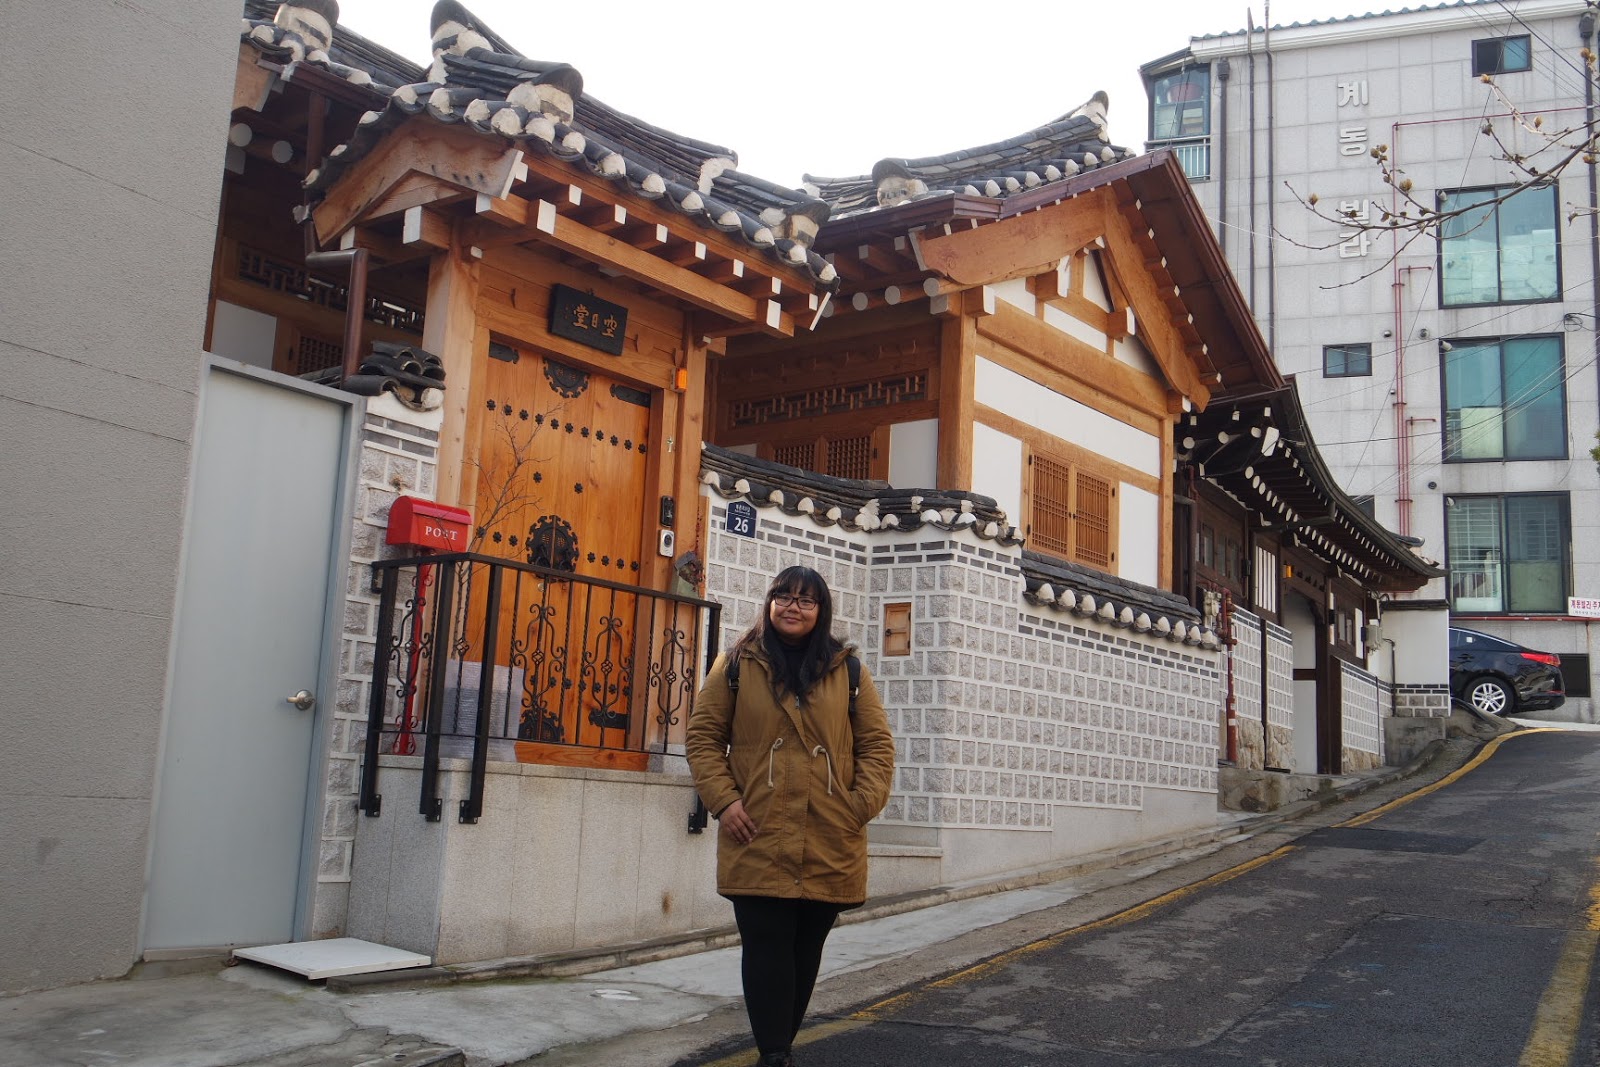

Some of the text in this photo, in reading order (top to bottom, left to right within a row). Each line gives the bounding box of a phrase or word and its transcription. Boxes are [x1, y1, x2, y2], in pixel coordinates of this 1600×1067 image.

[1337, 80, 1371, 259] 계동 빌라
[425, 525, 458, 541] POST
[734, 517, 749, 534] 26
